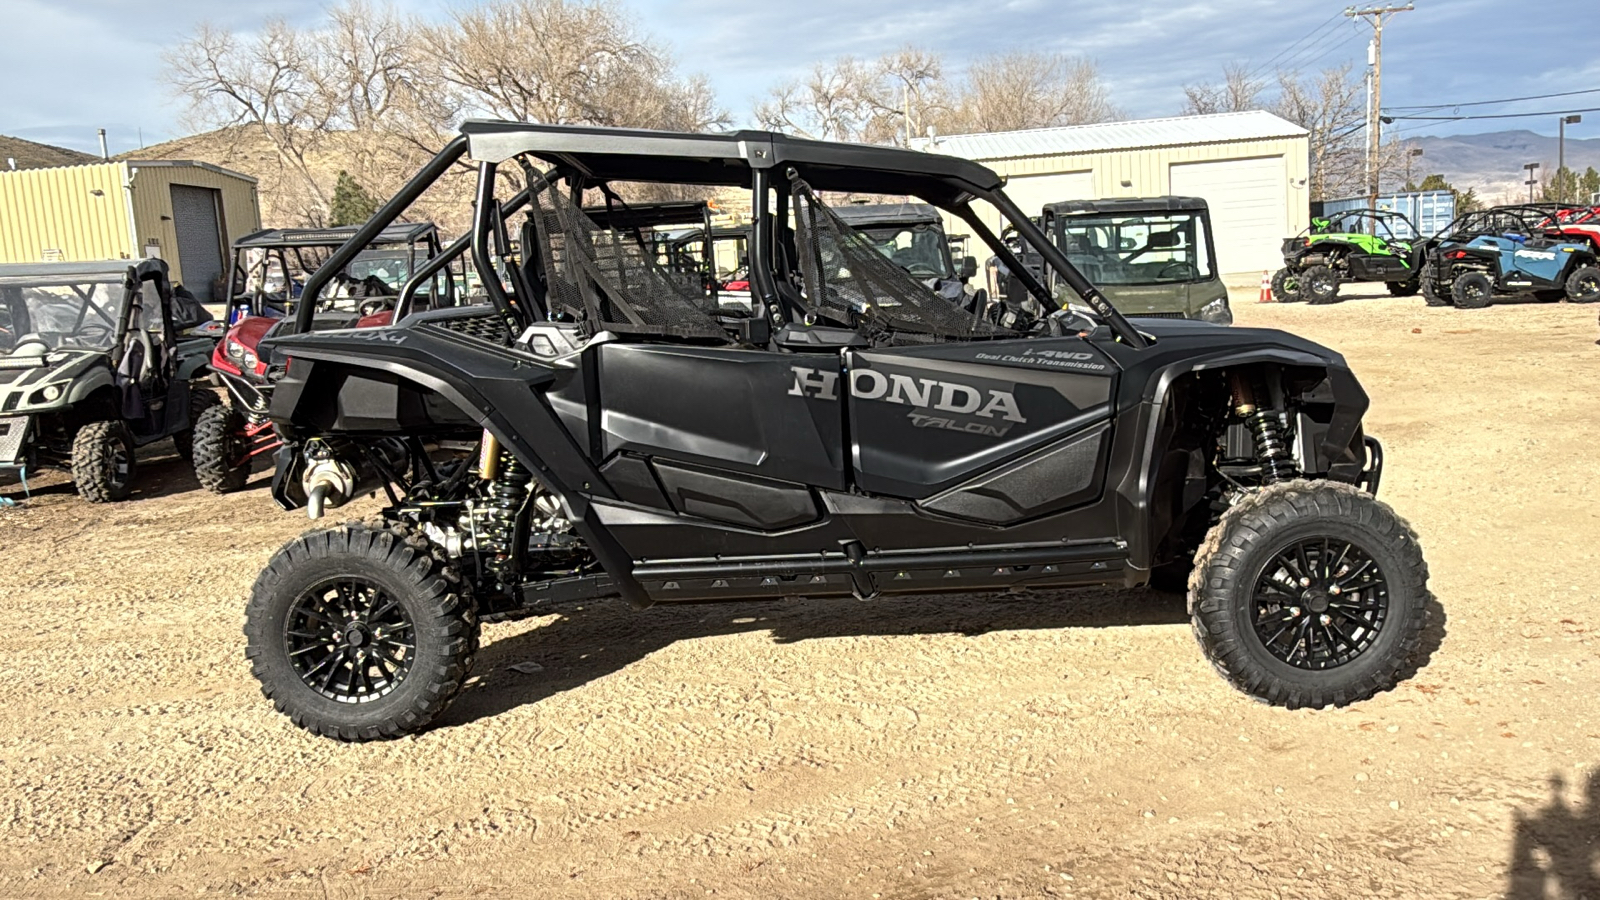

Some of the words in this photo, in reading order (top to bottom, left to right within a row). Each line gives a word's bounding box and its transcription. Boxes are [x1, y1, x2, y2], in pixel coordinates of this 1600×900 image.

[1002, 355, 1035, 364] Clutch
[1036, 358, 1105, 370] Transmission
[788, 366, 1027, 423] HONDA
[907, 413, 1009, 437] TALON
